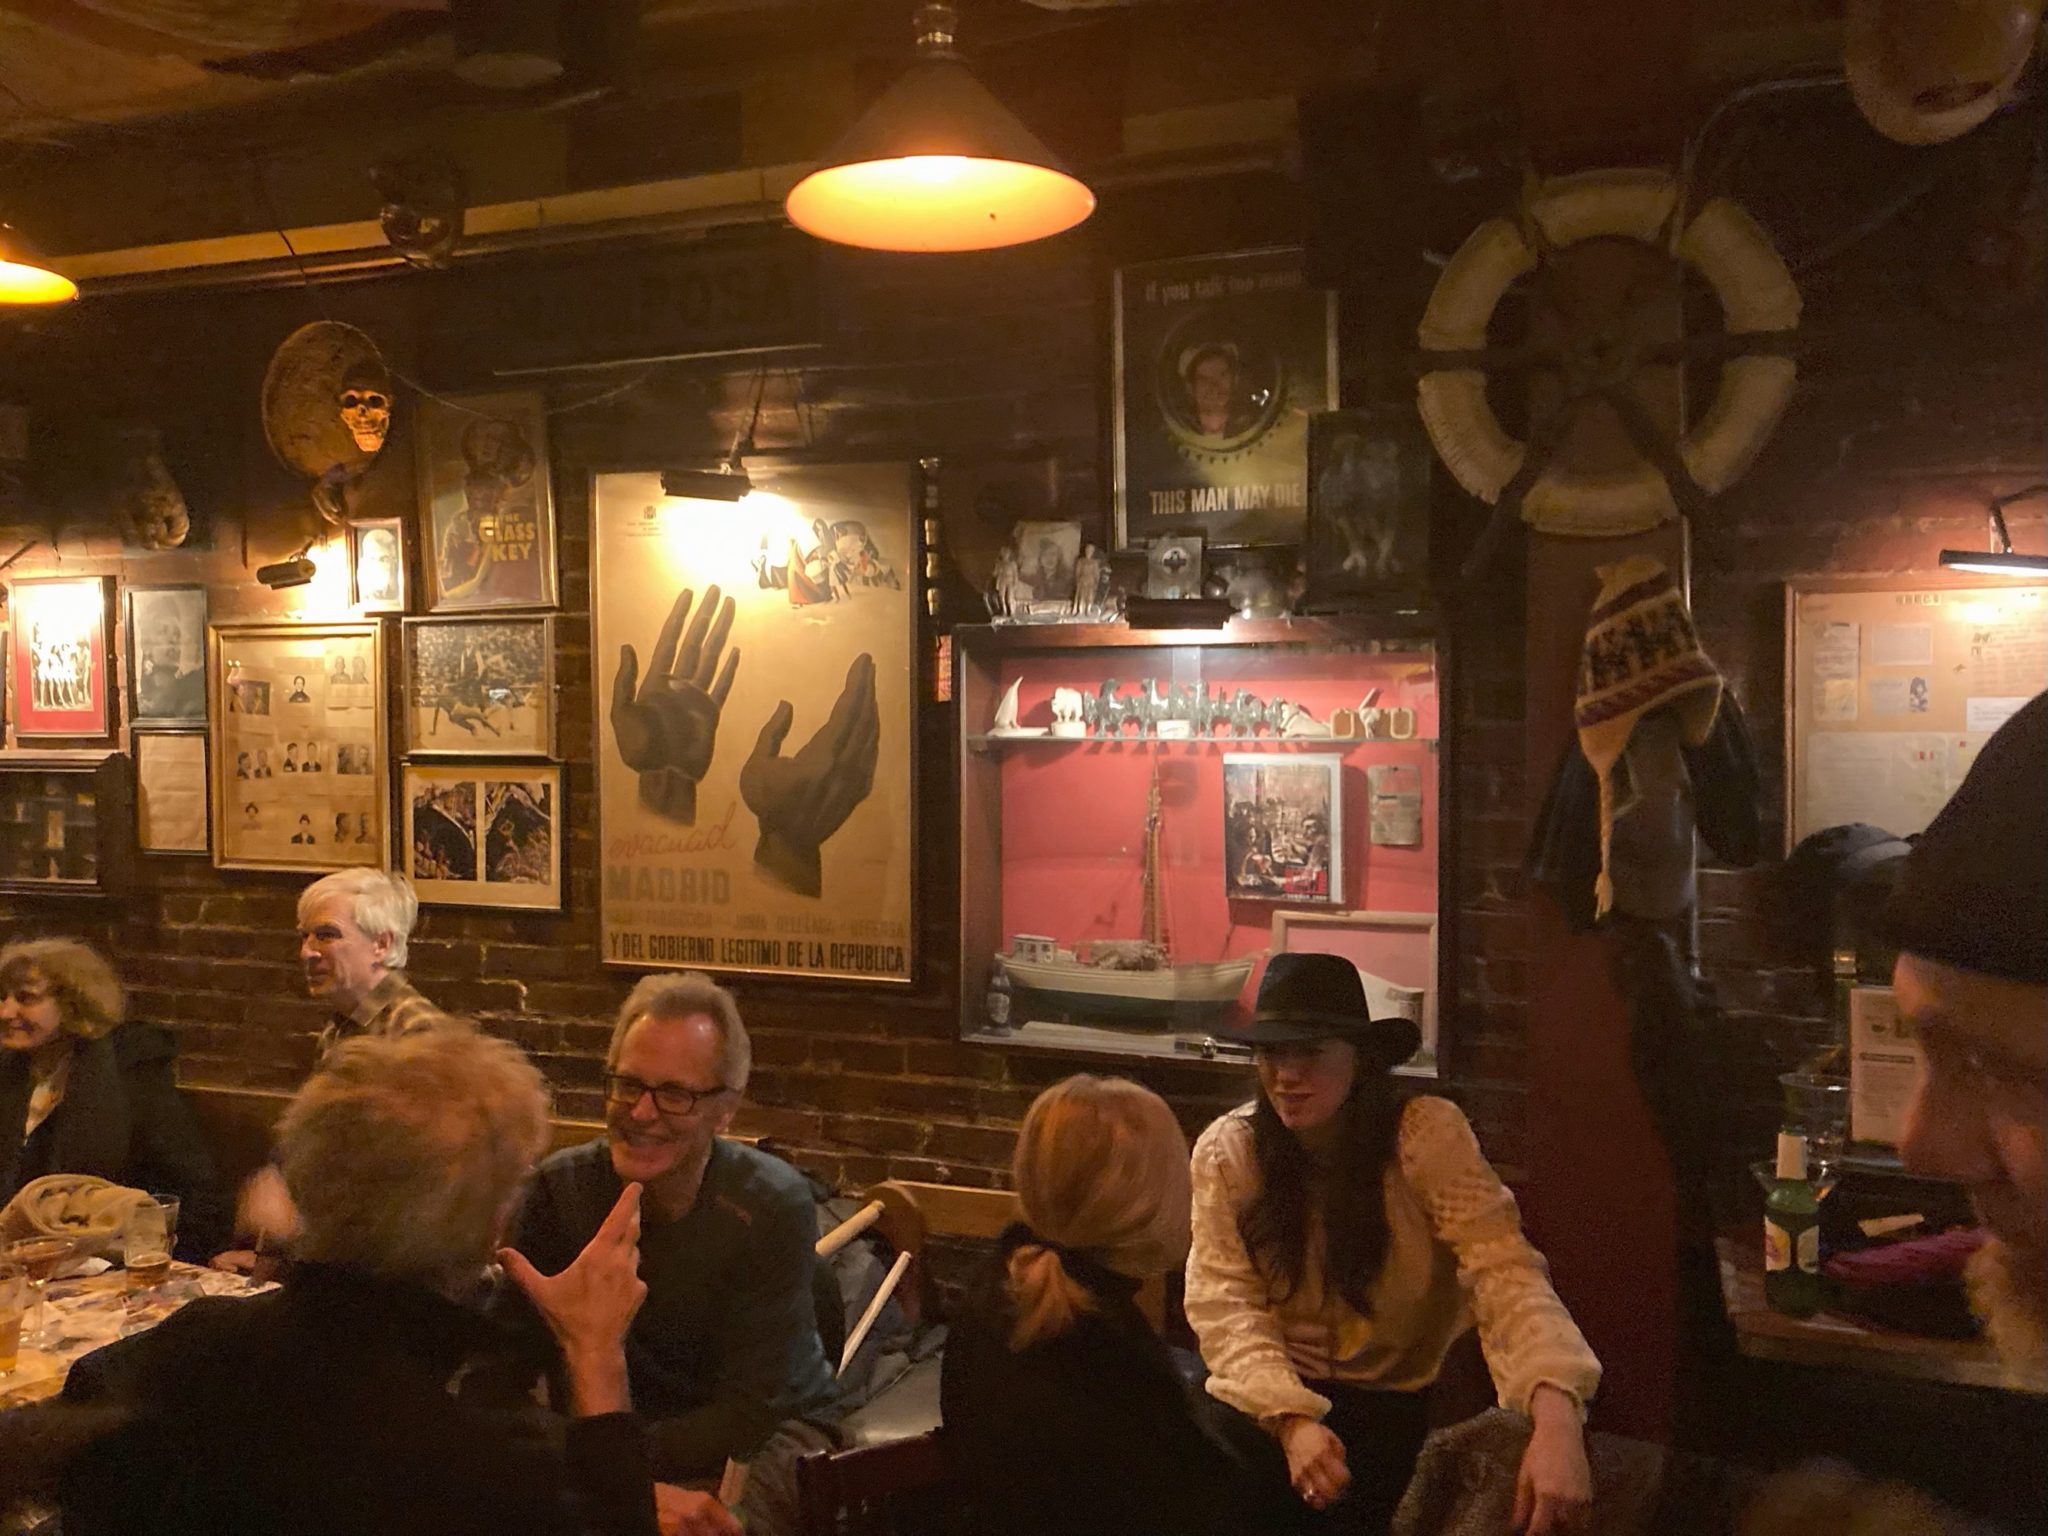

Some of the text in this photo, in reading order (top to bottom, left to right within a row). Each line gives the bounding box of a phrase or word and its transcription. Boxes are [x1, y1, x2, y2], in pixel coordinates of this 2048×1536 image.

[1162, 283, 1189, 306] you
[1149, 482, 1301, 515] THIS MAN MAY DIE
[478, 514, 536, 543] GLASS
[492, 542, 532, 562] KEY
[606, 864, 731, 905] MADRID
[610, 933, 905, 972] Y DEL GOBIERNO LEGITIMO DE LA REPUBLICA
